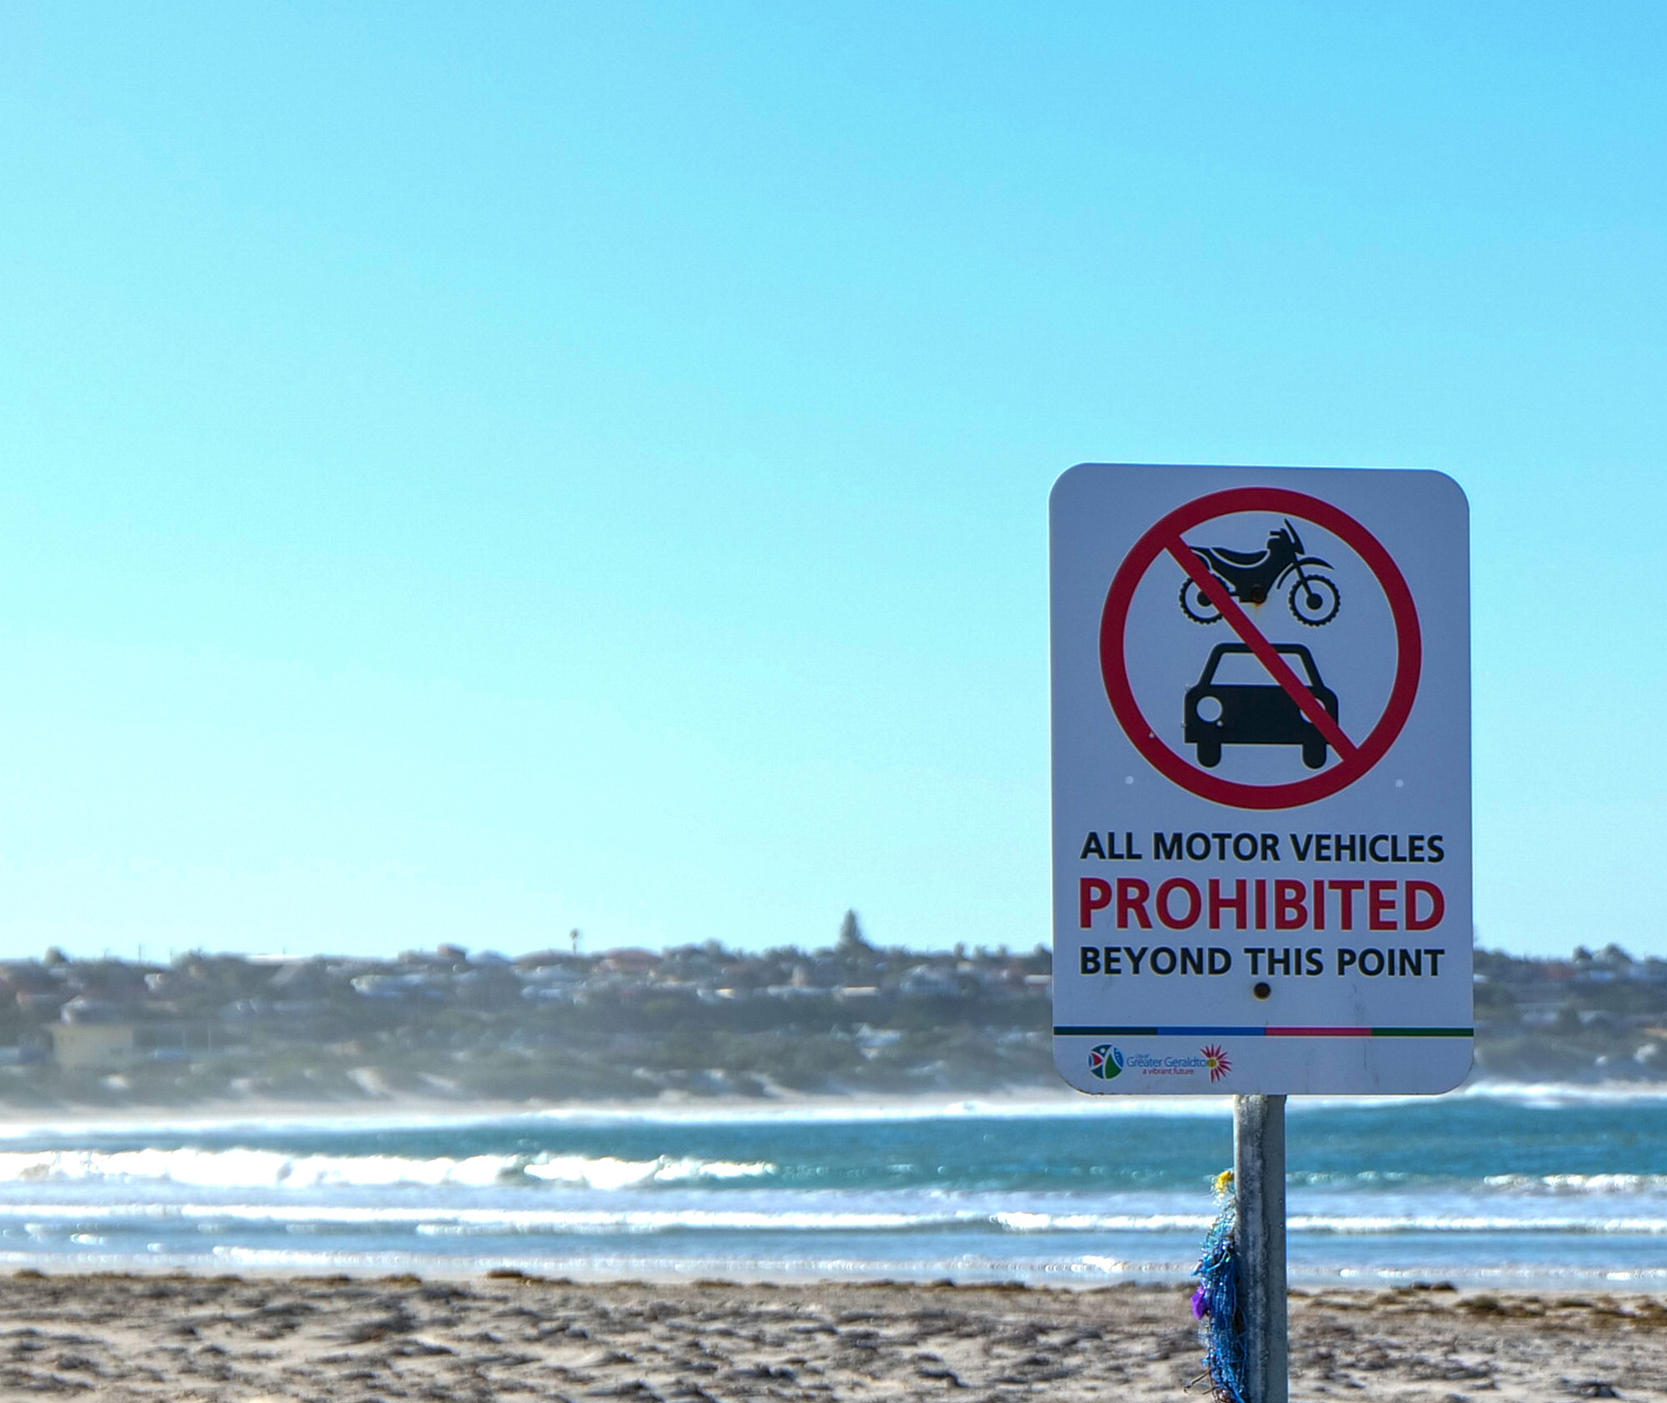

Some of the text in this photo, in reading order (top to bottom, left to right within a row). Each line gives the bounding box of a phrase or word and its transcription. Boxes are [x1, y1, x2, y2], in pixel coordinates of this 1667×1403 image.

[1080, 831, 1445, 863] ALL MOTOR VEHICLES
[1079, 877, 1445, 931] PROHIBITED
[1080, 946, 1446, 977] BEYOND THIS POINT
[1127, 1056, 1162, 1068] Greater
